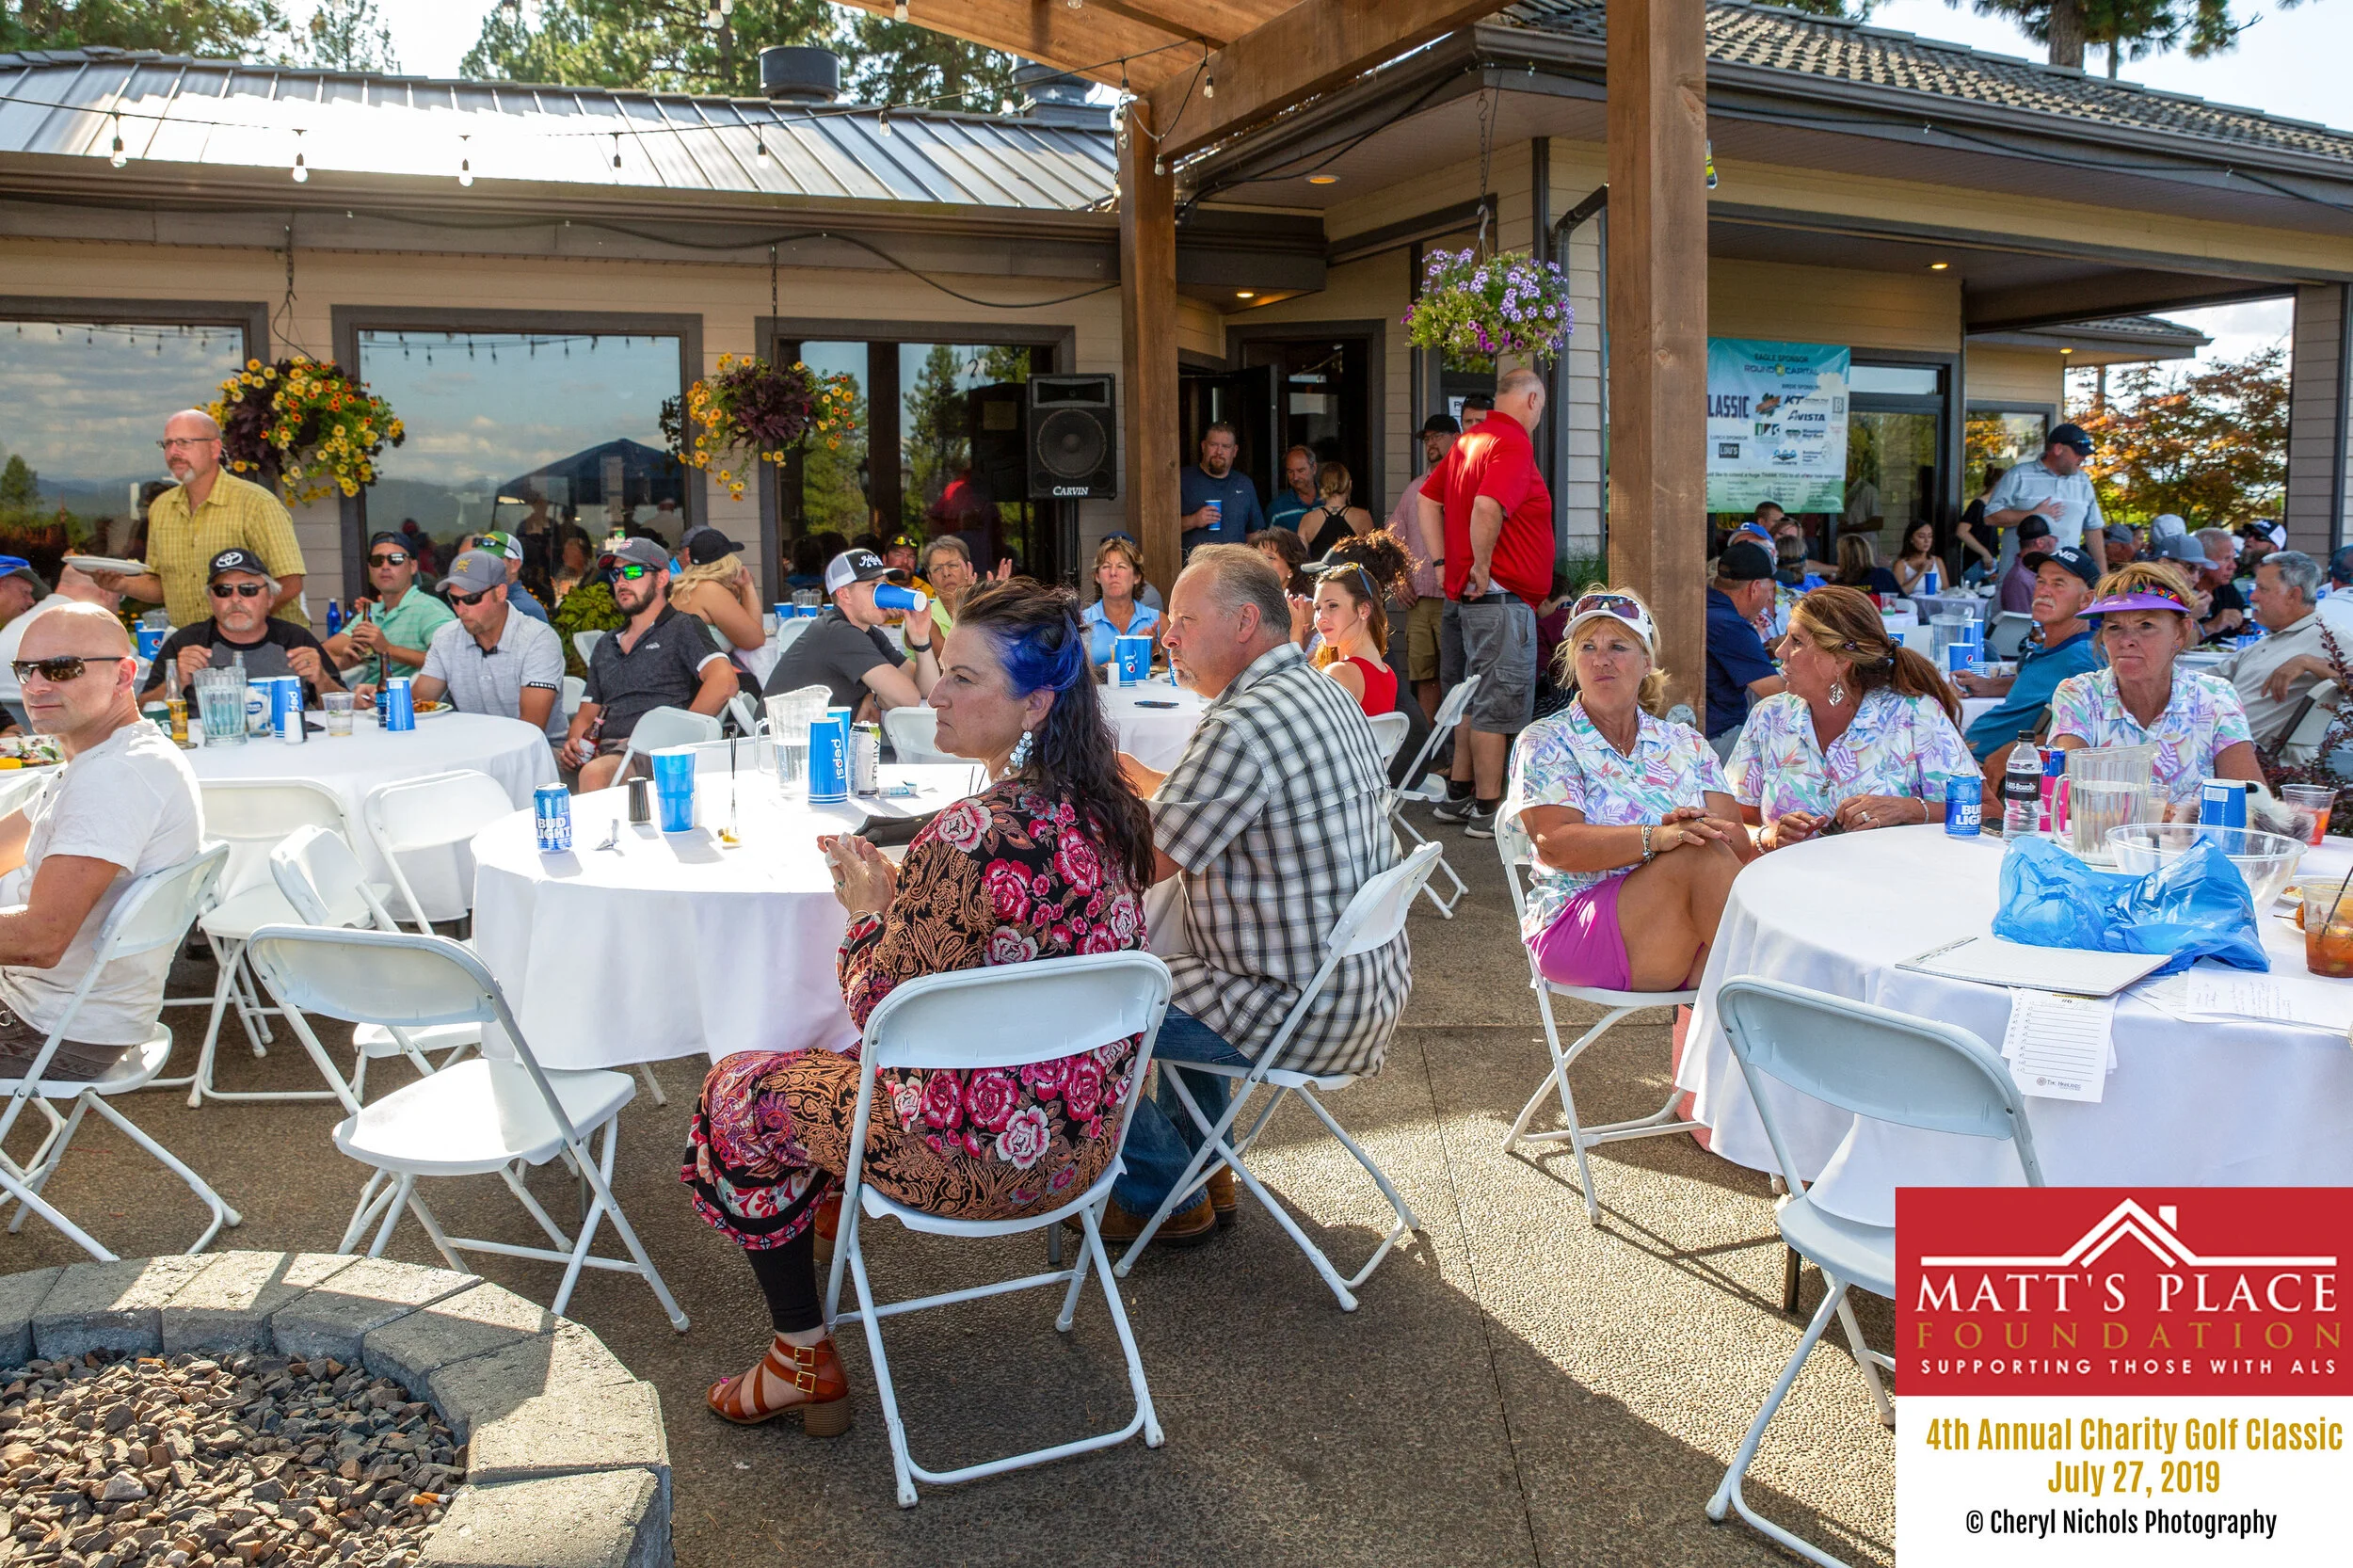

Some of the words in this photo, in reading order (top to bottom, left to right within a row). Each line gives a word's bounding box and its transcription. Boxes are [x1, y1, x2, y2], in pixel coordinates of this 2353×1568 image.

[1754, 353, 1777, 361] EAGLE
[1778, 354, 1809, 362] SPONSOR
[1744, 364, 1775, 374] ROUND
[1785, 366, 1819, 376] CAPITAL
[1707, 394, 1750, 419] LASSIC
[1784, 395, 1805, 406] KT
[1787, 409, 1826, 422] AVISTA
[1052, 486, 1089, 496] CARVIN
[831, 738, 846, 780] pepsi
[537, 817, 567, 829] BUD
[1955, 814, 1981, 826] LIG
